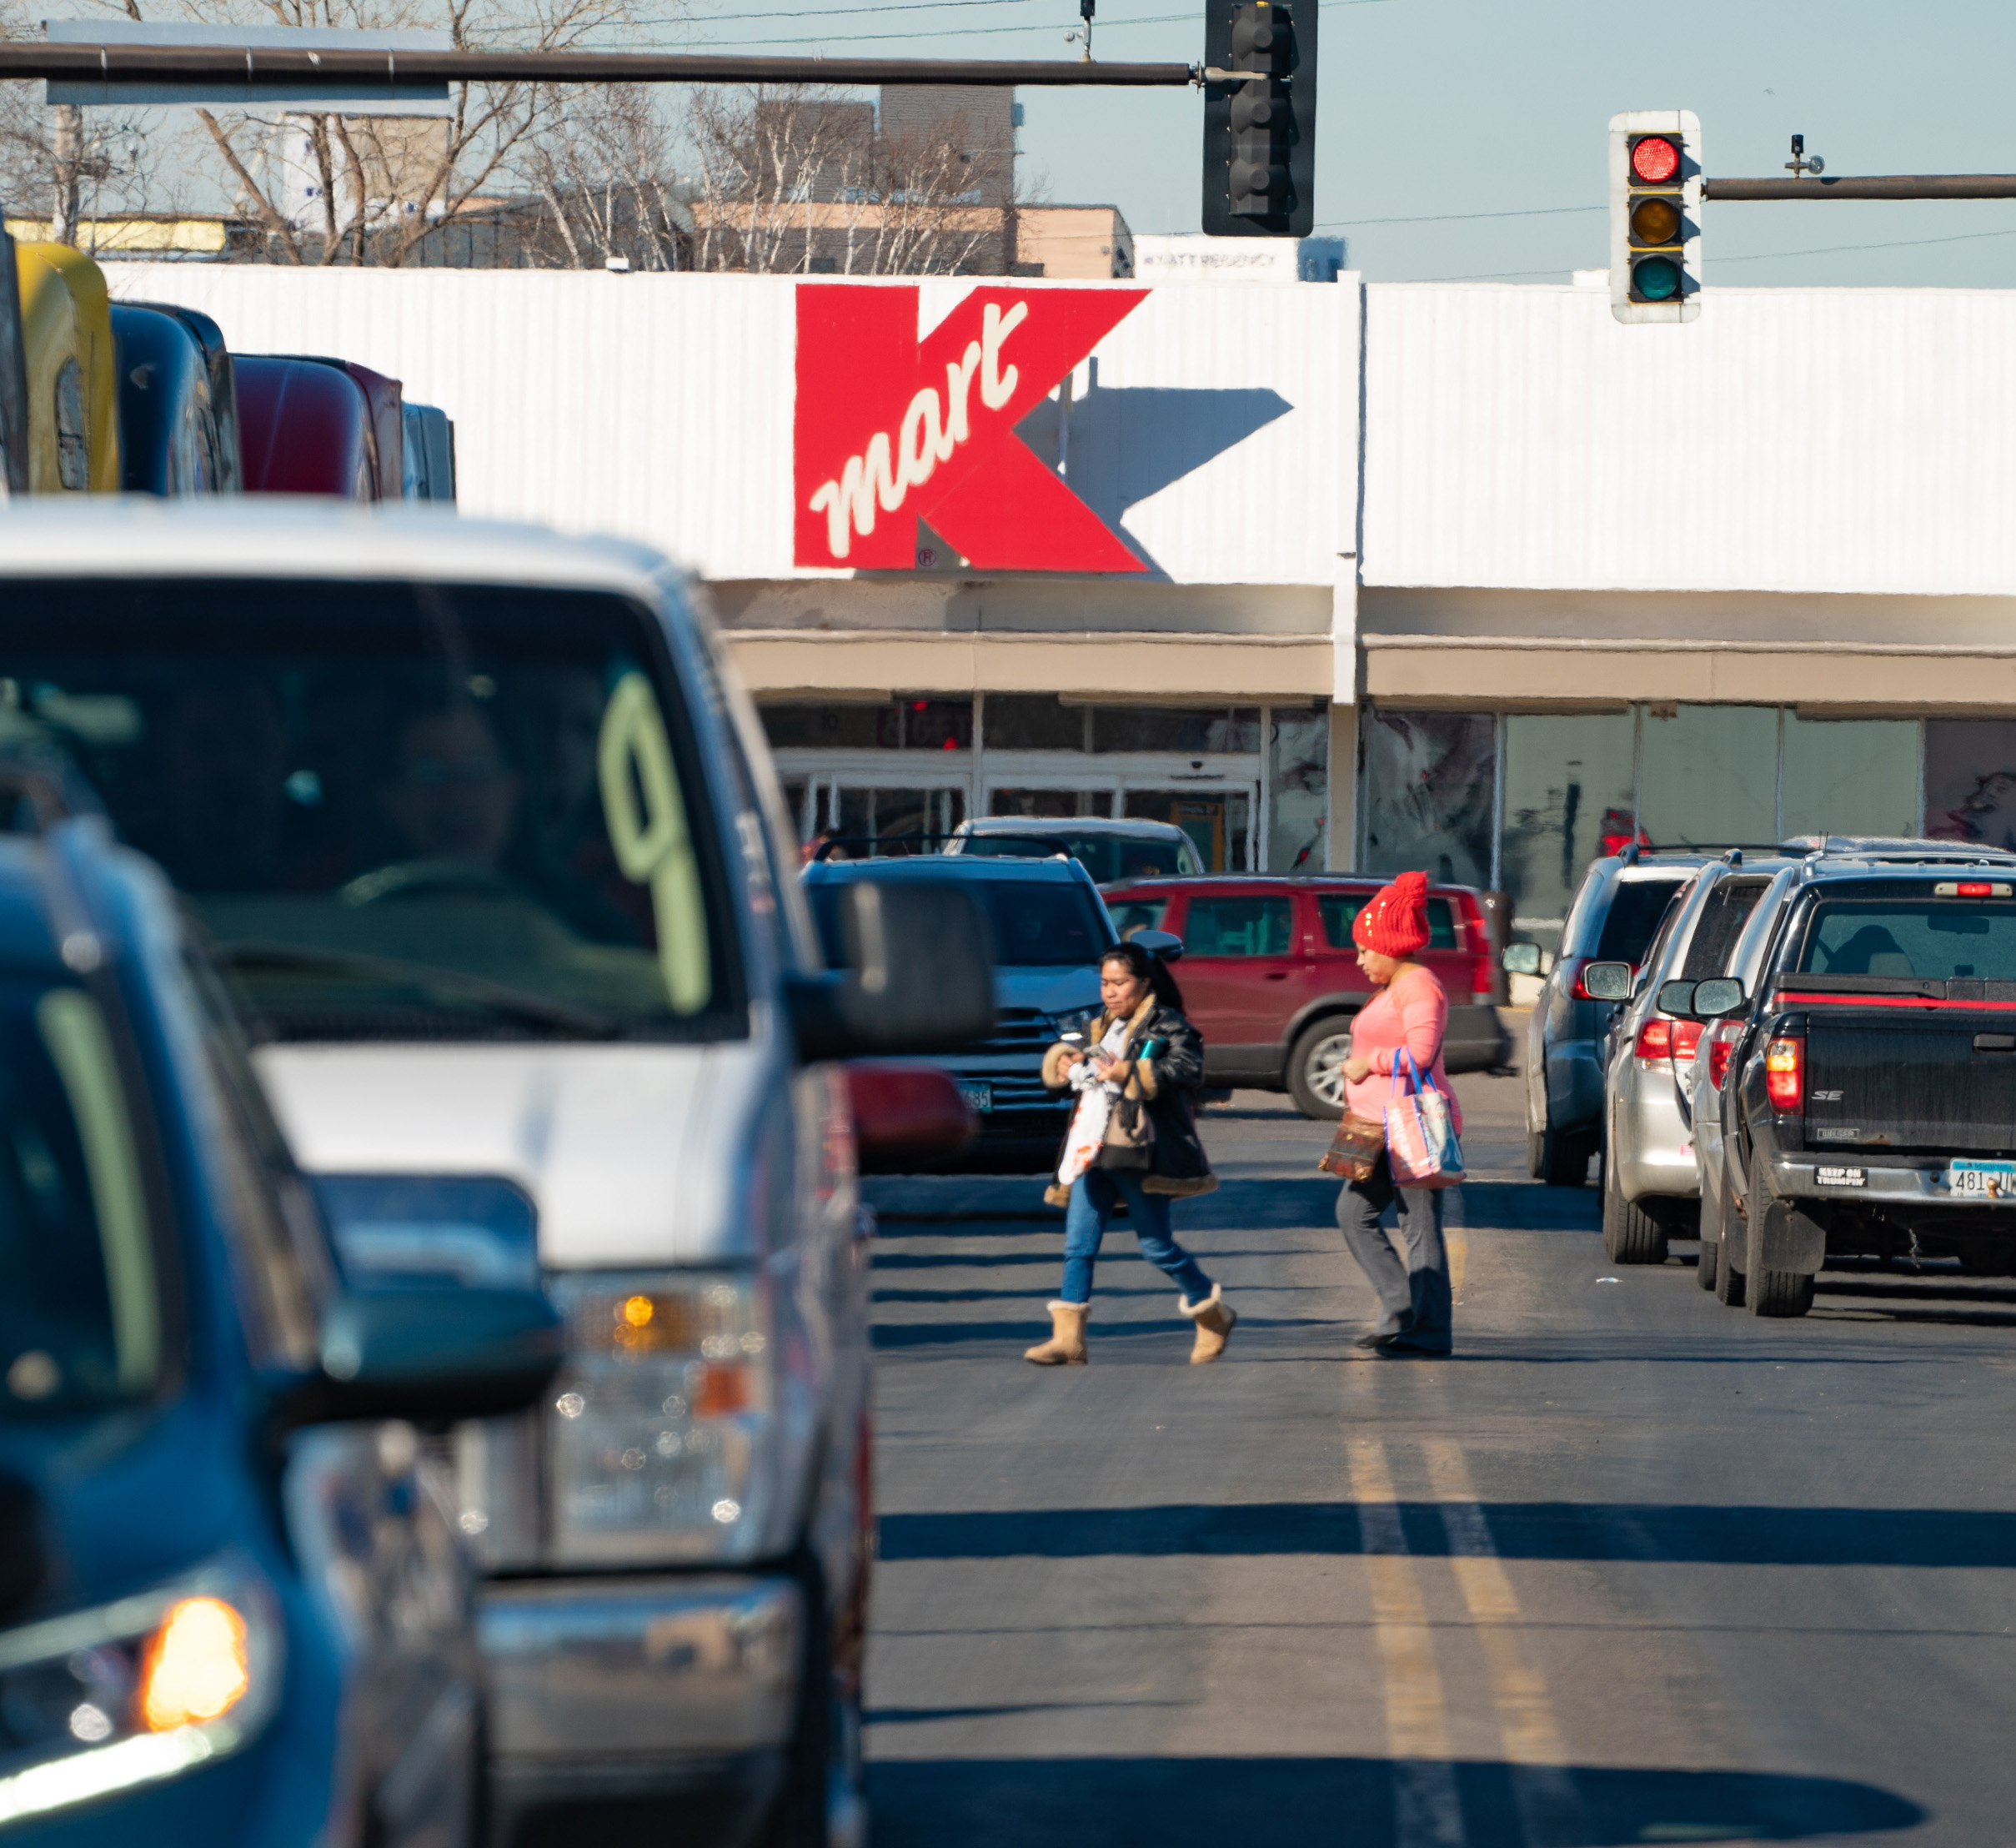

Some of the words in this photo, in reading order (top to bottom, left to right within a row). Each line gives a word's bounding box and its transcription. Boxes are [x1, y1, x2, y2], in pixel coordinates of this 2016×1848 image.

[1818, 1168, 1845, 1177] KEEP
[1846, 1168, 1861, 1178] ON
[1956, 1172, 1985, 1190] 481
